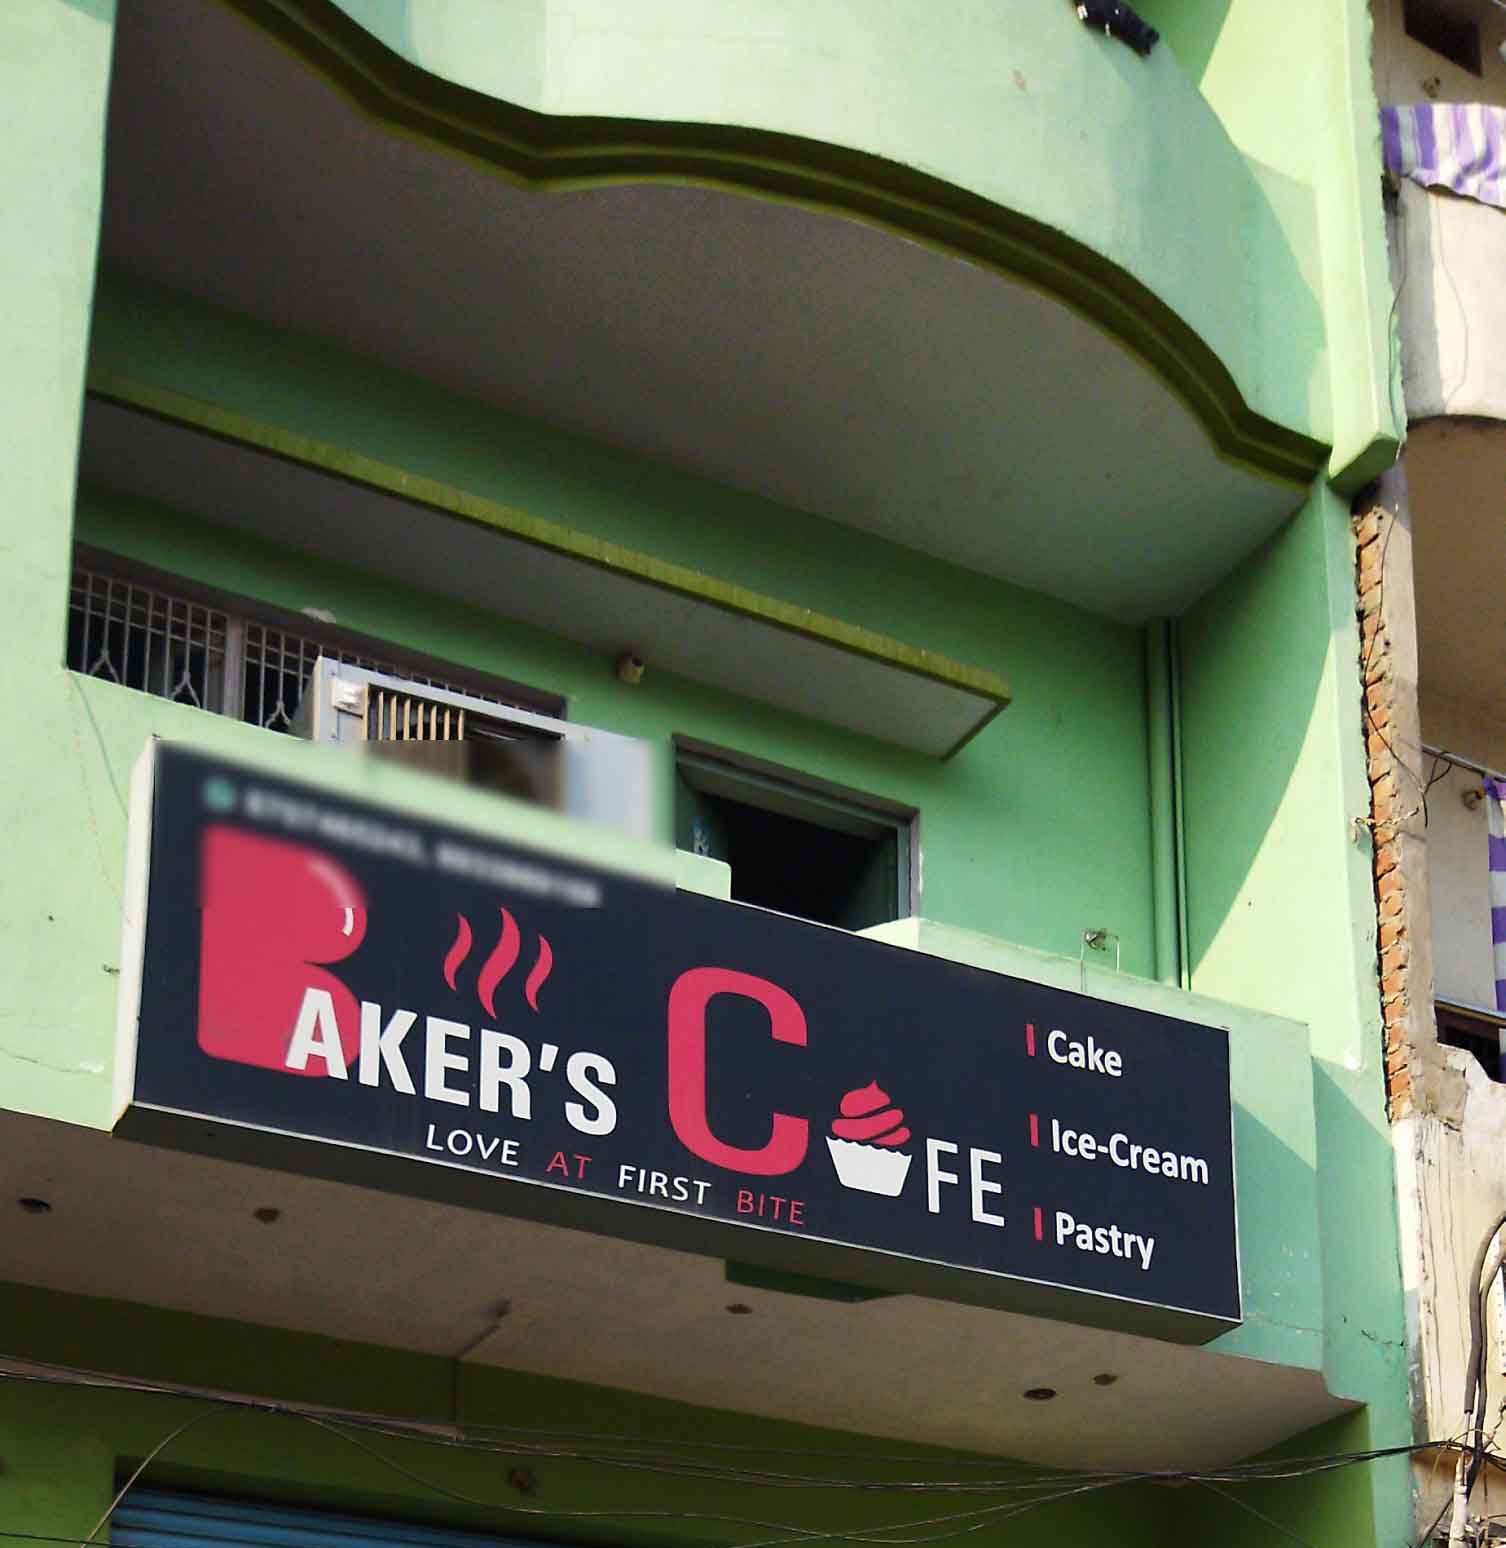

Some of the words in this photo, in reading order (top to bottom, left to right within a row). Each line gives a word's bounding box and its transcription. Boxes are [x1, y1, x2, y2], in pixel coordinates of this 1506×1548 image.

[1047, 1029, 1122, 1077] Cake
[425, 1123, 520, 1166] LOVE
[546, 1151, 592, 1180] AT
[618, 1164, 711, 1205] FIRST
[737, 1189, 805, 1225] BITE
[1051, 1119, 1209, 1185] Ice-Cream
[1056, 1211, 1155, 1271] Pastry
